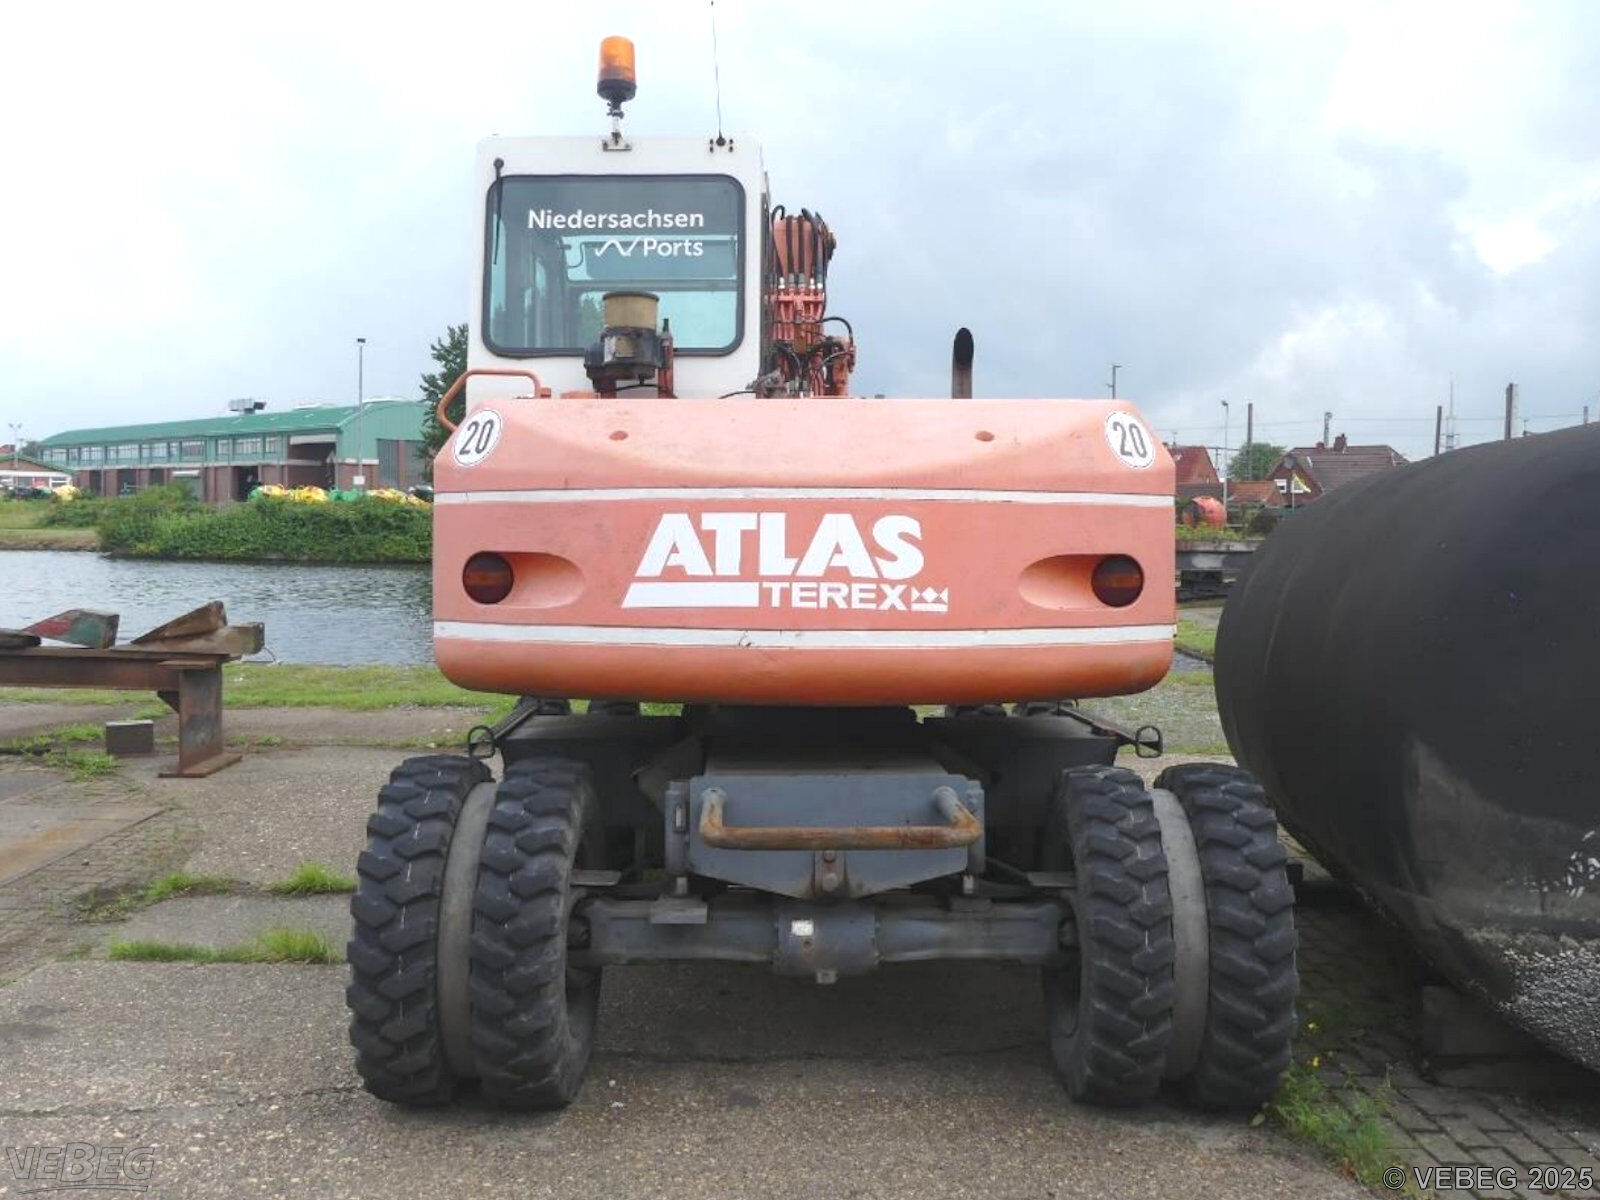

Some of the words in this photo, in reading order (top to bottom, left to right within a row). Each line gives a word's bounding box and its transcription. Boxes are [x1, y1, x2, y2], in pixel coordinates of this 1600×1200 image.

[528, 209, 704, 230] Niedersachsen
[643, 237, 704, 257] Ports
[459, 419, 494, 456] 20
[1113, 421, 1147, 458] 20
[635, 512, 924, 580] ATLAS
[762, 581, 909, 611] TEREX
